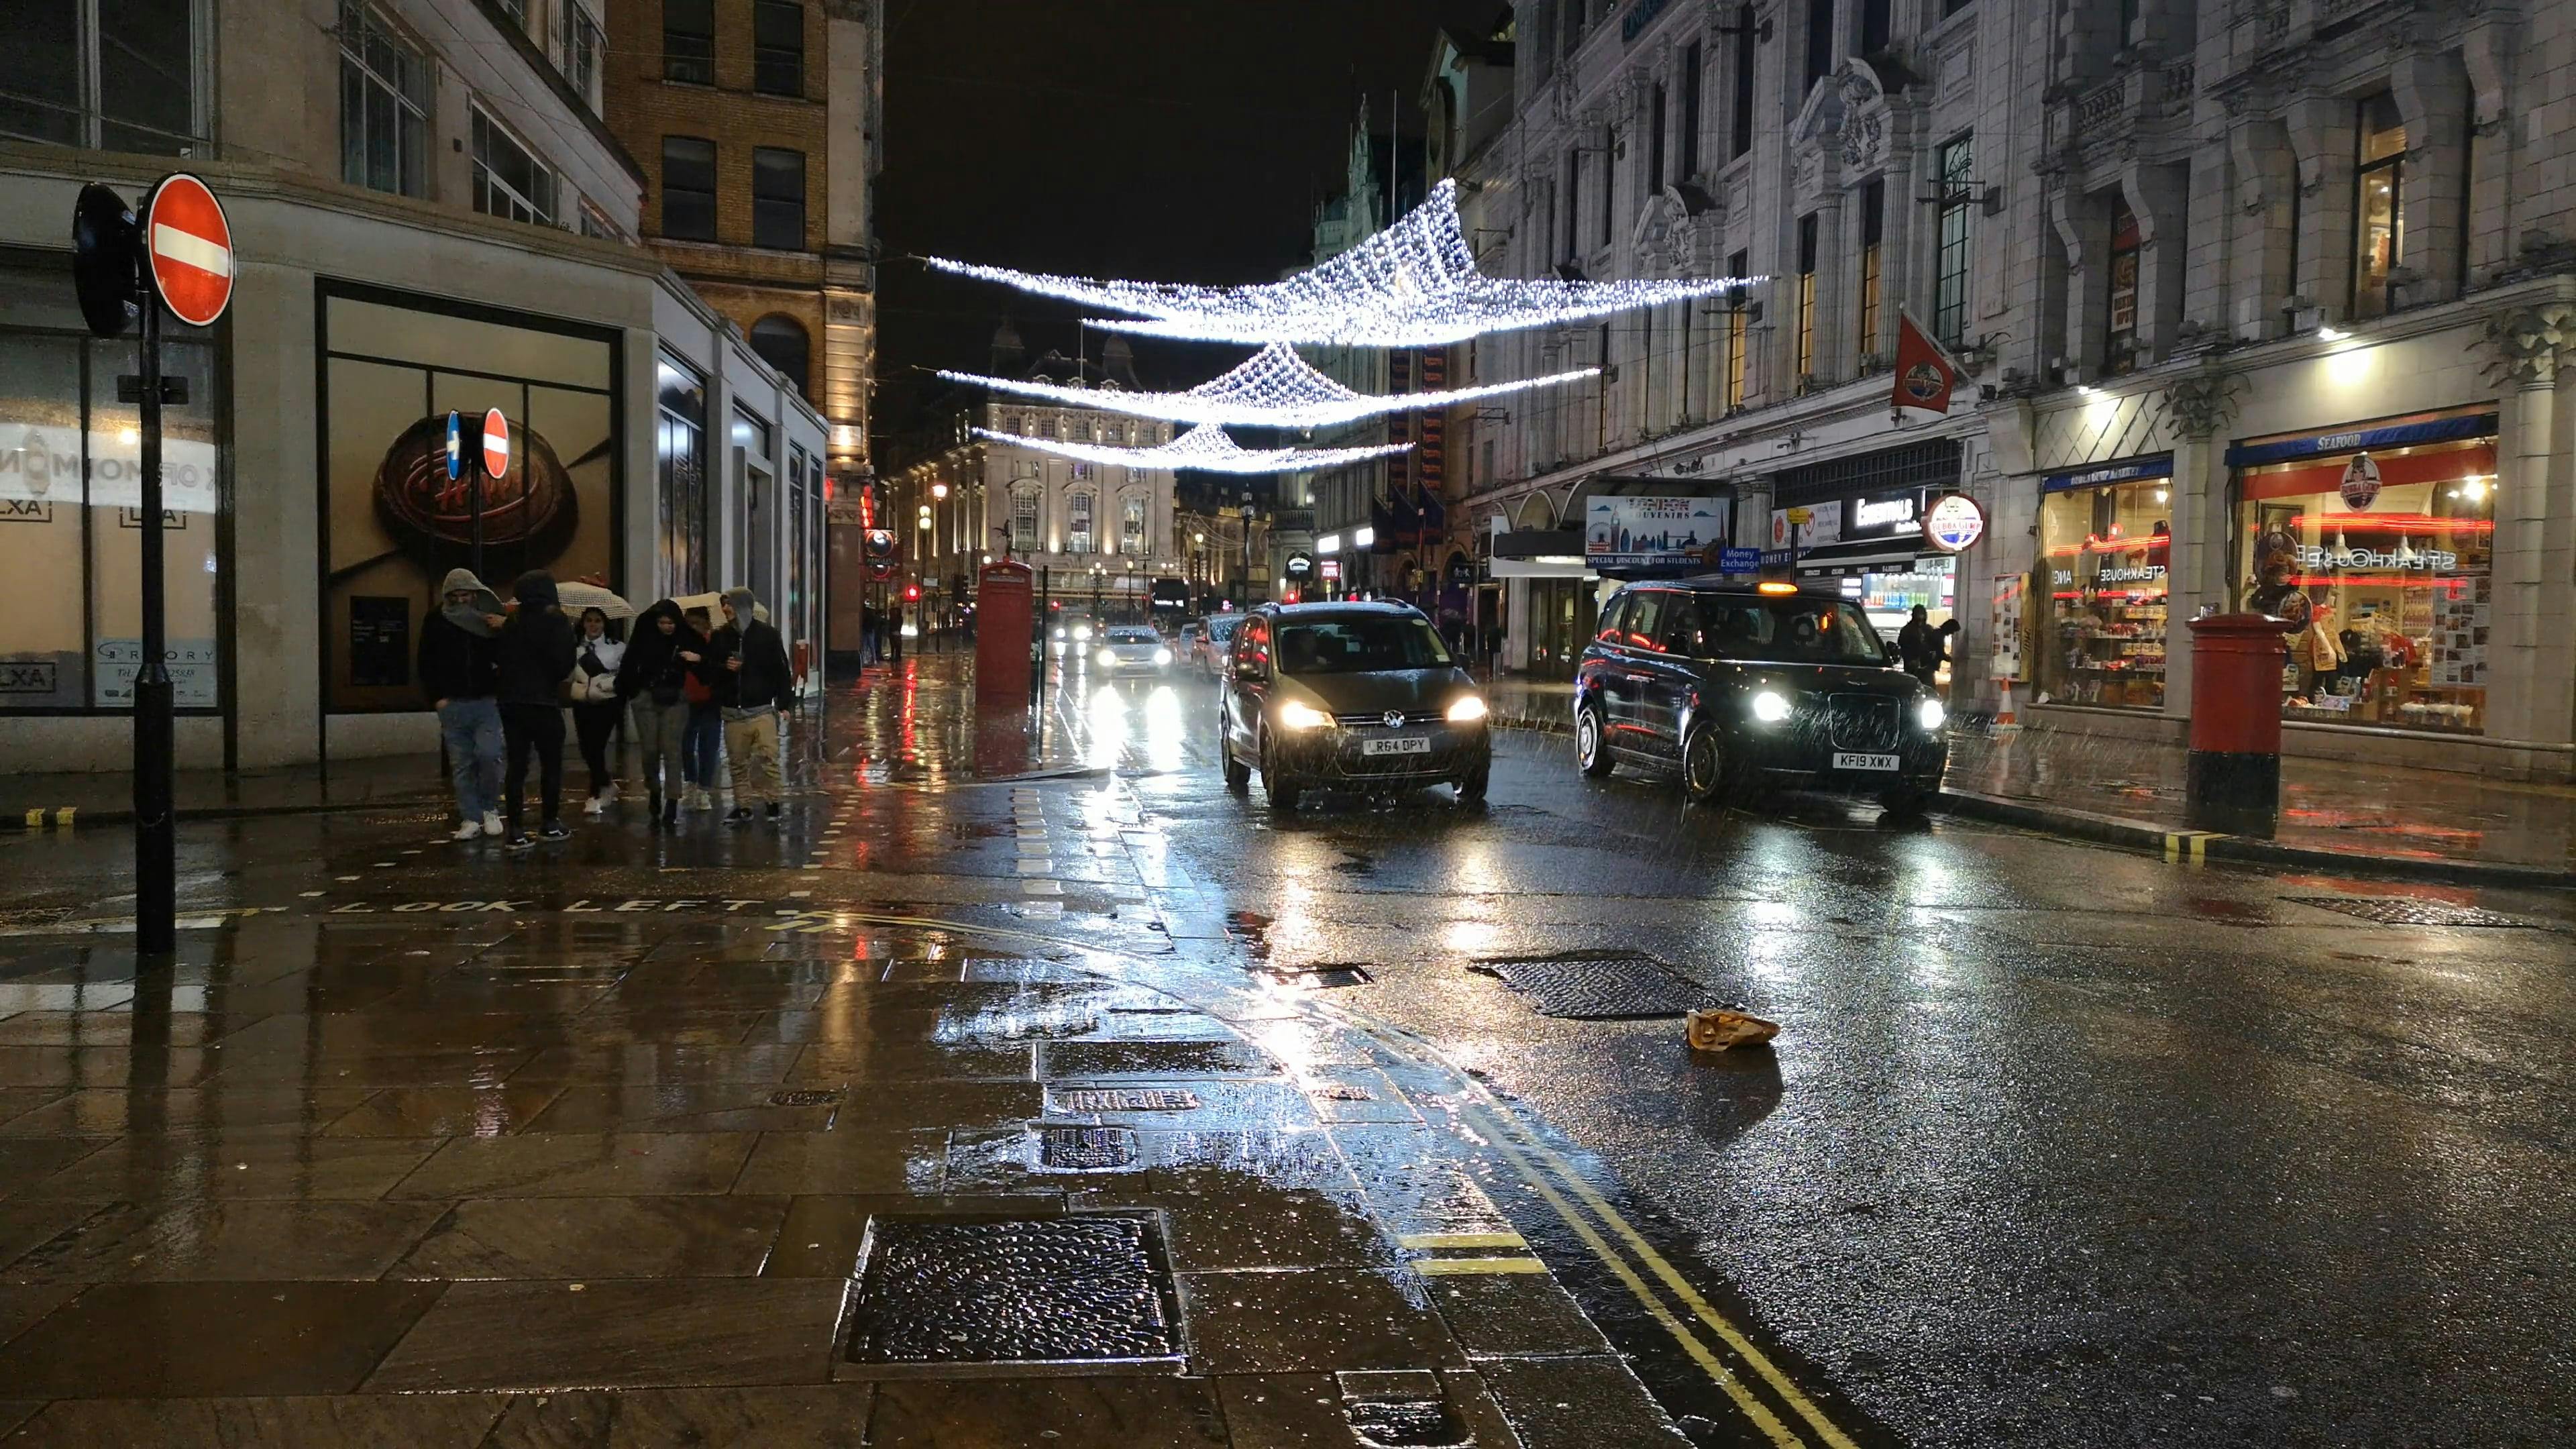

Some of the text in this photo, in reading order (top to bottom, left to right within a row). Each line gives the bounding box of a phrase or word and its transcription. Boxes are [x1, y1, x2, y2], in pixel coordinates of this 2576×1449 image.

[2317, 433, 2361, 450] SEAFOOD
[1726, 549, 1754, 559] Money
[1587, 557, 1614, 565] SPECIAL
[1666, 557, 1701, 565] STUDENTS
[1720, 559, 1760, 570] Exchange
[1402, 739, 1425, 751] DPY
[1840, 755, 1892, 768] KF19 XWX
[330, 900, 765, 913] LOOK LEFT
